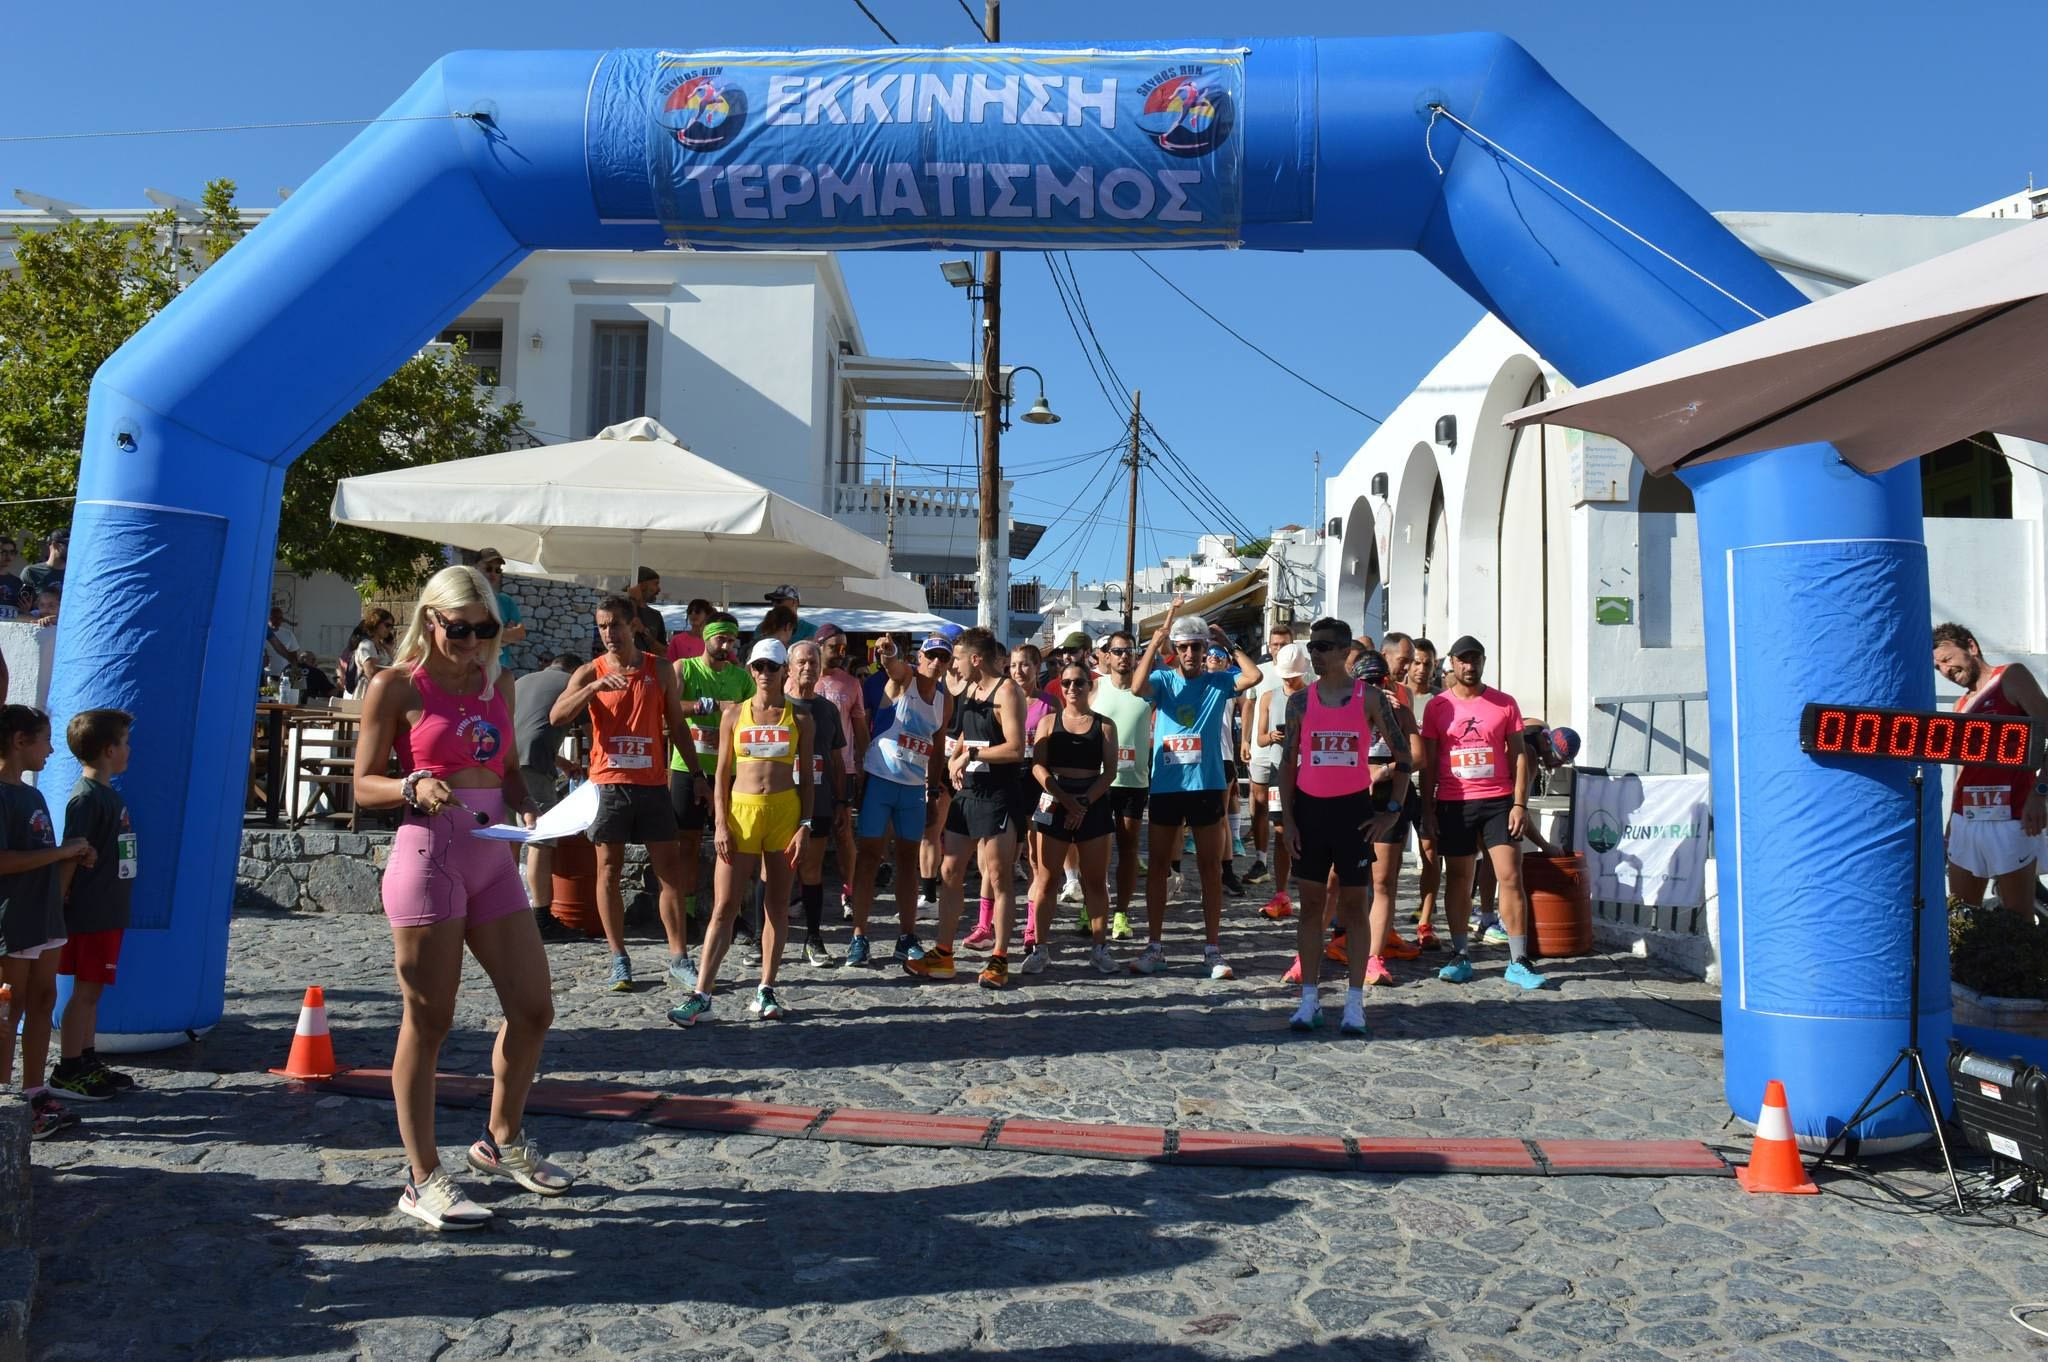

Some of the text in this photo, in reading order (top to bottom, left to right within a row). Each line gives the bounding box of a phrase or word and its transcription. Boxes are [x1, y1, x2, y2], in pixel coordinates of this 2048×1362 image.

[1180, 65, 1203, 76] RUN
[765, 74, 1118, 130] ΕΚΚΙΝΗΣΗ
[683, 163, 1204, 222] ΤΕΡΜΑΤΙΣΜΟΣ
[617, 741, 645, 755] 125
[906, 737, 929, 754] 133
[1168, 738, 1194, 751] 129
[1319, 737, 1350, 751] 126
[1458, 752, 1487, 767] 135
